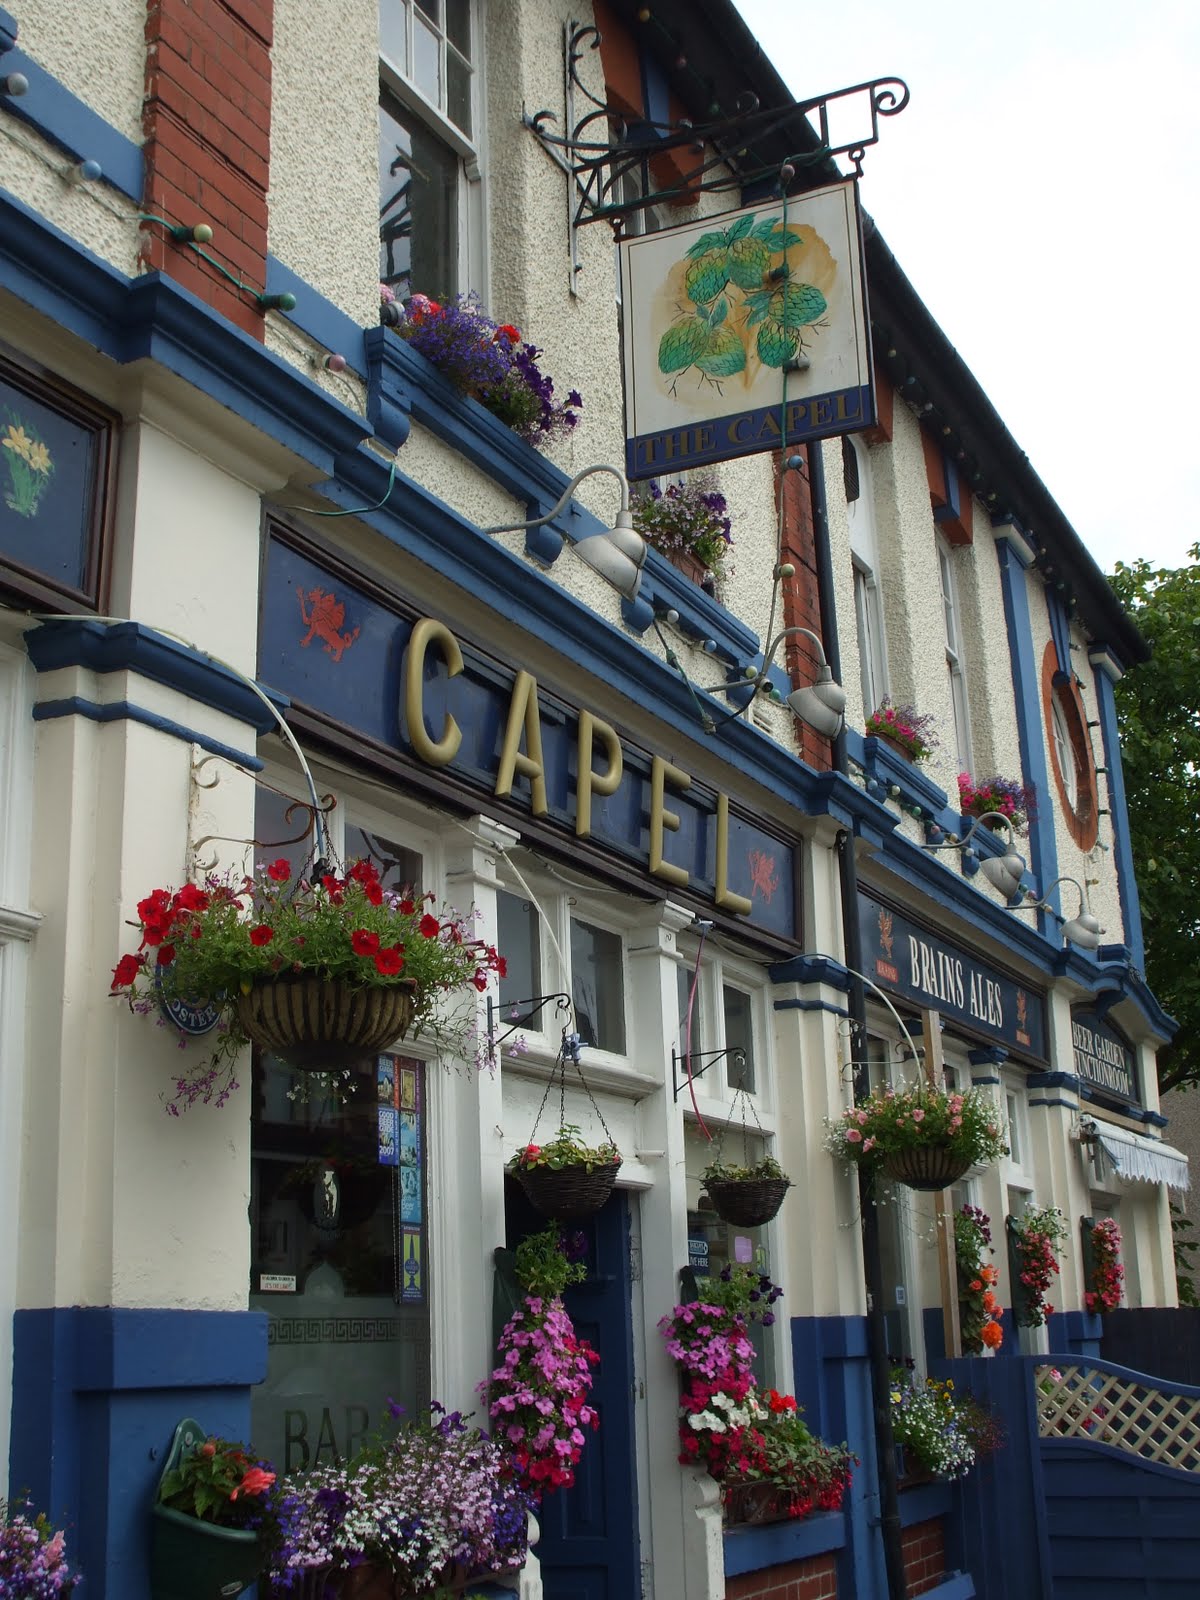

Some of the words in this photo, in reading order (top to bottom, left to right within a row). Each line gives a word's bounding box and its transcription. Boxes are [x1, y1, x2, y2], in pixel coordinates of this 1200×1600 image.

[637, 424, 718, 465] THE
[726, 394, 861, 445] CAPEL
[405, 617, 753, 917] CAPEL
[908, 934, 964, 1010] BRAINS
[969, 969, 1003, 1029] ALES
[1071, 1020, 1095, 1055] BEER
[1094, 1033, 1126, 1071] GARDEN
[379, 1111, 394, 1120] GOOD
[379, 1117, 394, 1127] BEER
[379, 1145, 394, 1155] 2007
[284, 1406, 369, 1474] BAR
